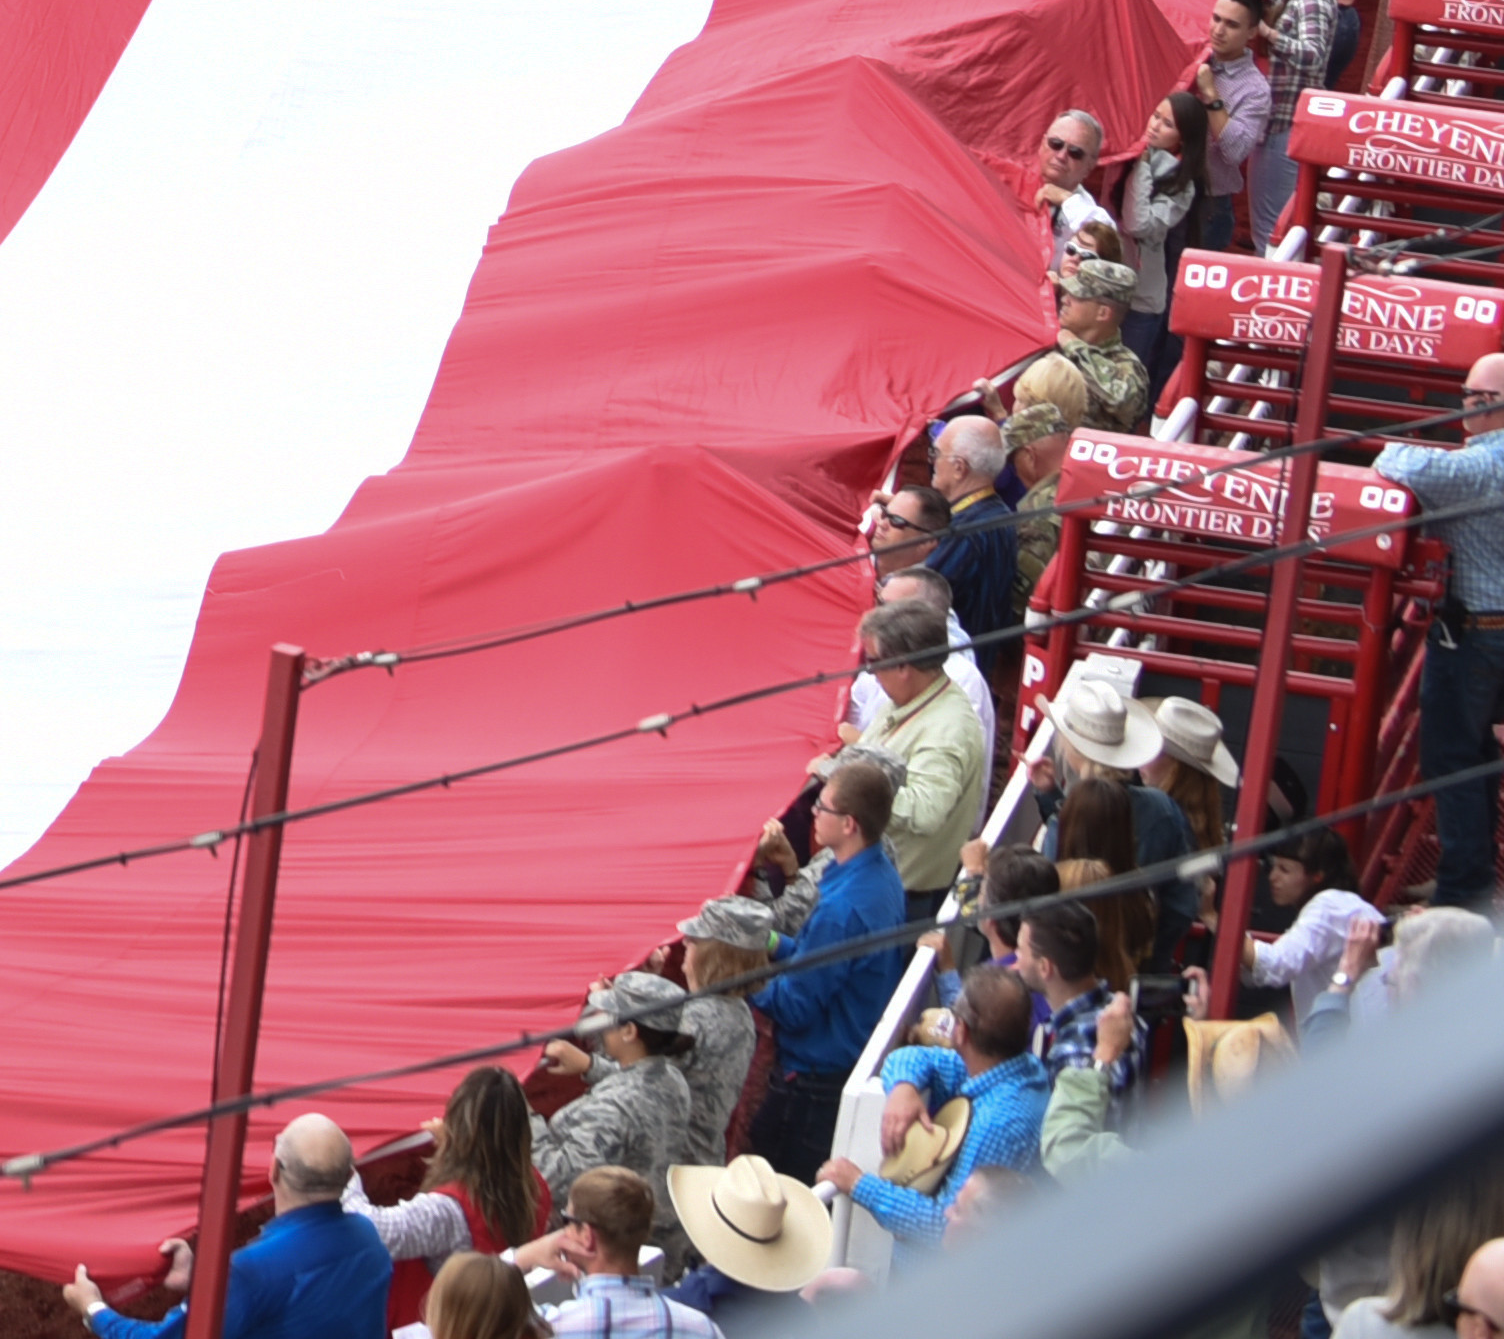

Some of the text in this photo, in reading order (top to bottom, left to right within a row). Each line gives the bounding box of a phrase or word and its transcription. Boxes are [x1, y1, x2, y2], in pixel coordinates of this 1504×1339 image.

[1307, 96, 1346, 117] 8
[1347, 147, 1468, 183] FRONTIER
[1184, 263, 1497, 332] 00 CHEENNE 00
[1369, 331, 1435, 357] DAYS
[1070, 439, 1117, 465] 00
[1360, 485, 1407, 513] 00
[1105, 497, 1243, 535] FRONTIER
